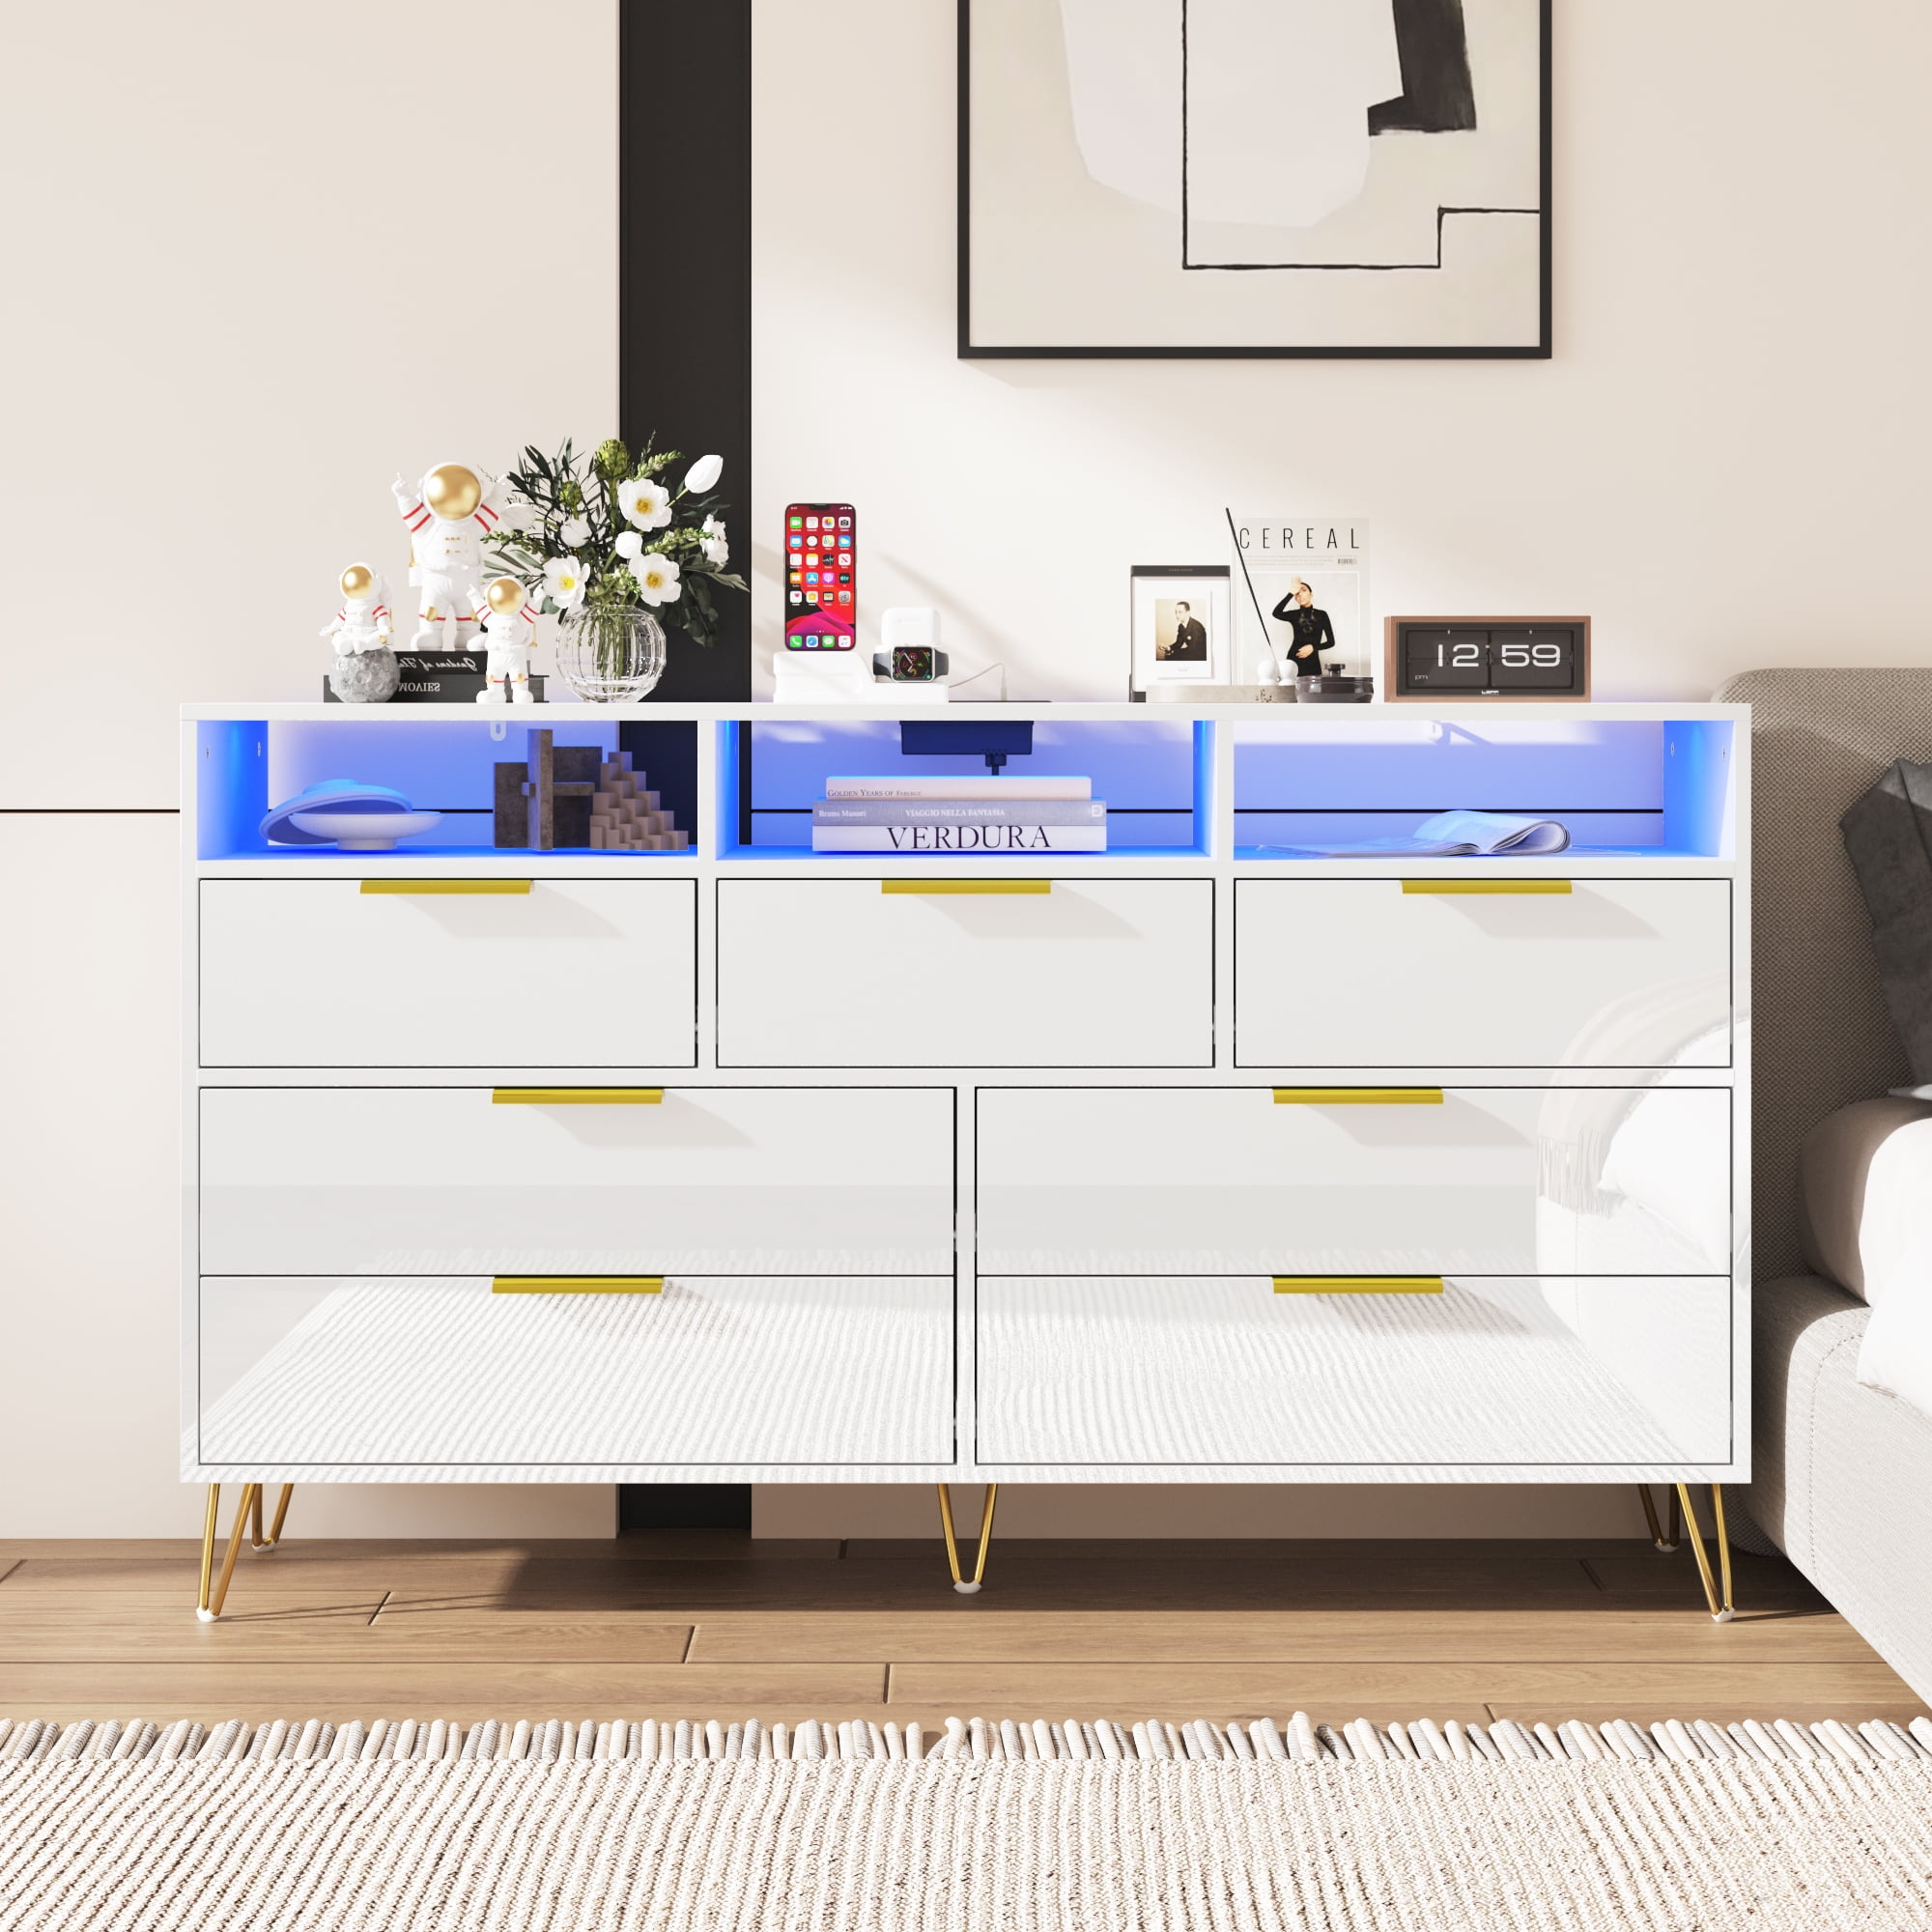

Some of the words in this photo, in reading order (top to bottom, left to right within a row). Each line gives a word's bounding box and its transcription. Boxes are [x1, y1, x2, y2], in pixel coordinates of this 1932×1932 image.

[1239, 527, 1360, 549] CEREAL
[1437, 644, 1480, 668] 12
[1501, 644, 1561, 668] 59
[860, 788, 883, 797] YEARS
[887, 825, 1052, 850] VERDURA
